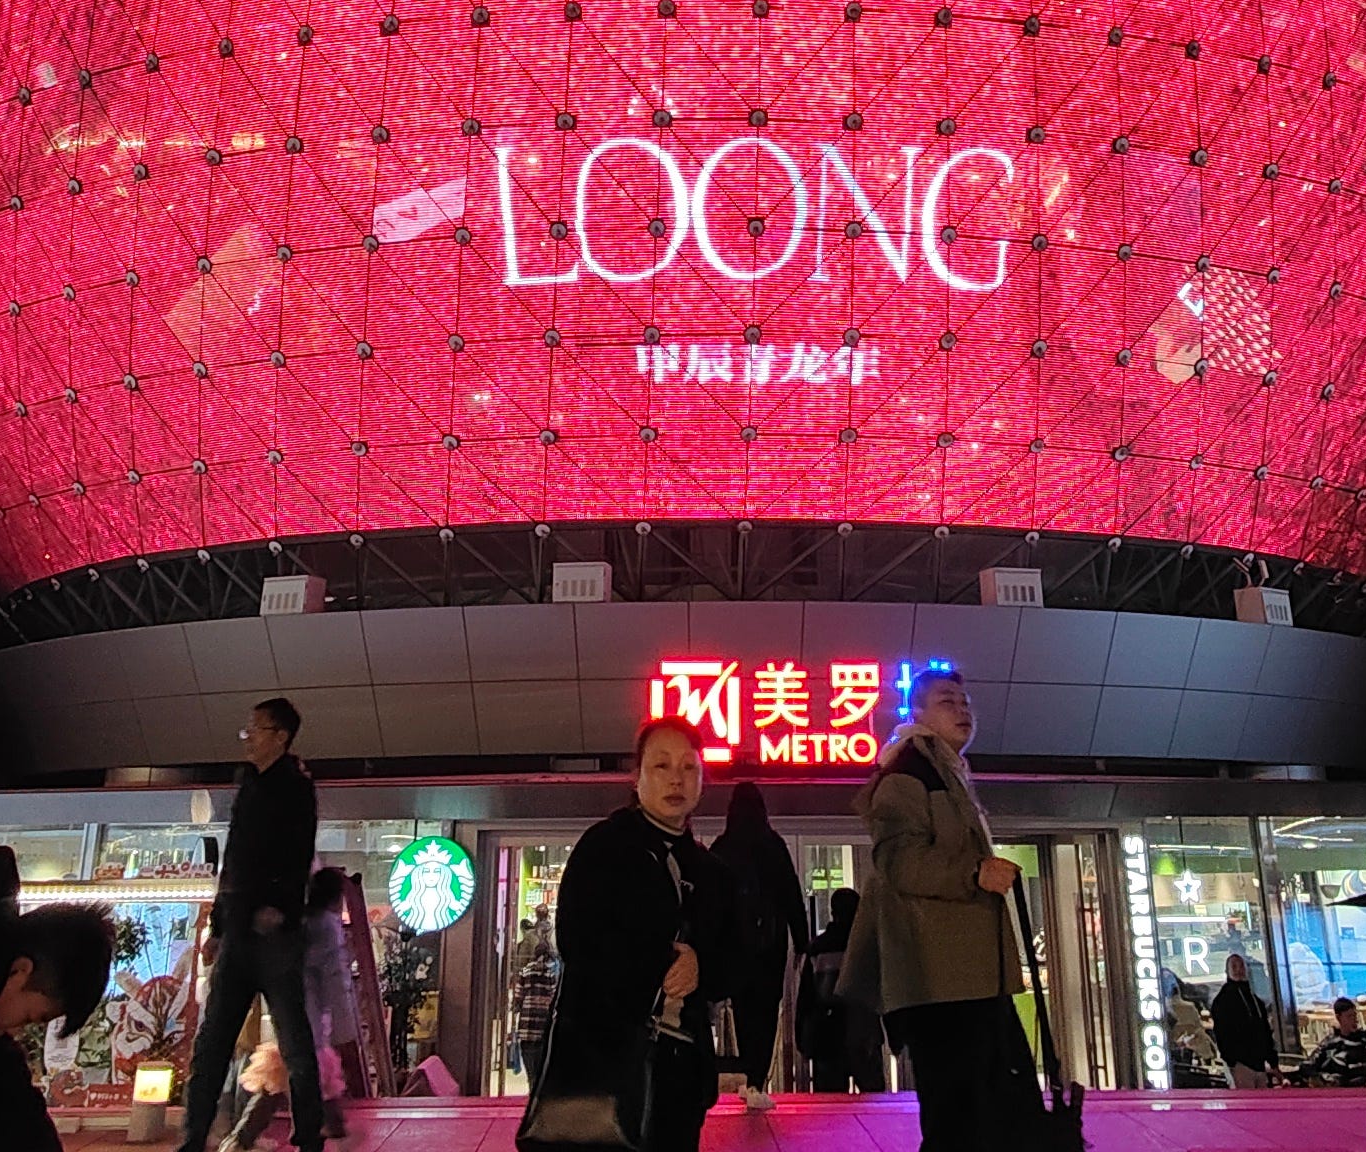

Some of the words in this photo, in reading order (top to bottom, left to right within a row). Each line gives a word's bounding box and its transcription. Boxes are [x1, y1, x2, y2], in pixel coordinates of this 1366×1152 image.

[496, 137, 1015, 290] LOONG
[636, 343, 882, 386] 甲辰青龙年
[760, 733, 878, 762] METRO
[1124, 835, 1161, 1021] STARBUCKS
[1183, 936, 1210, 975] R
